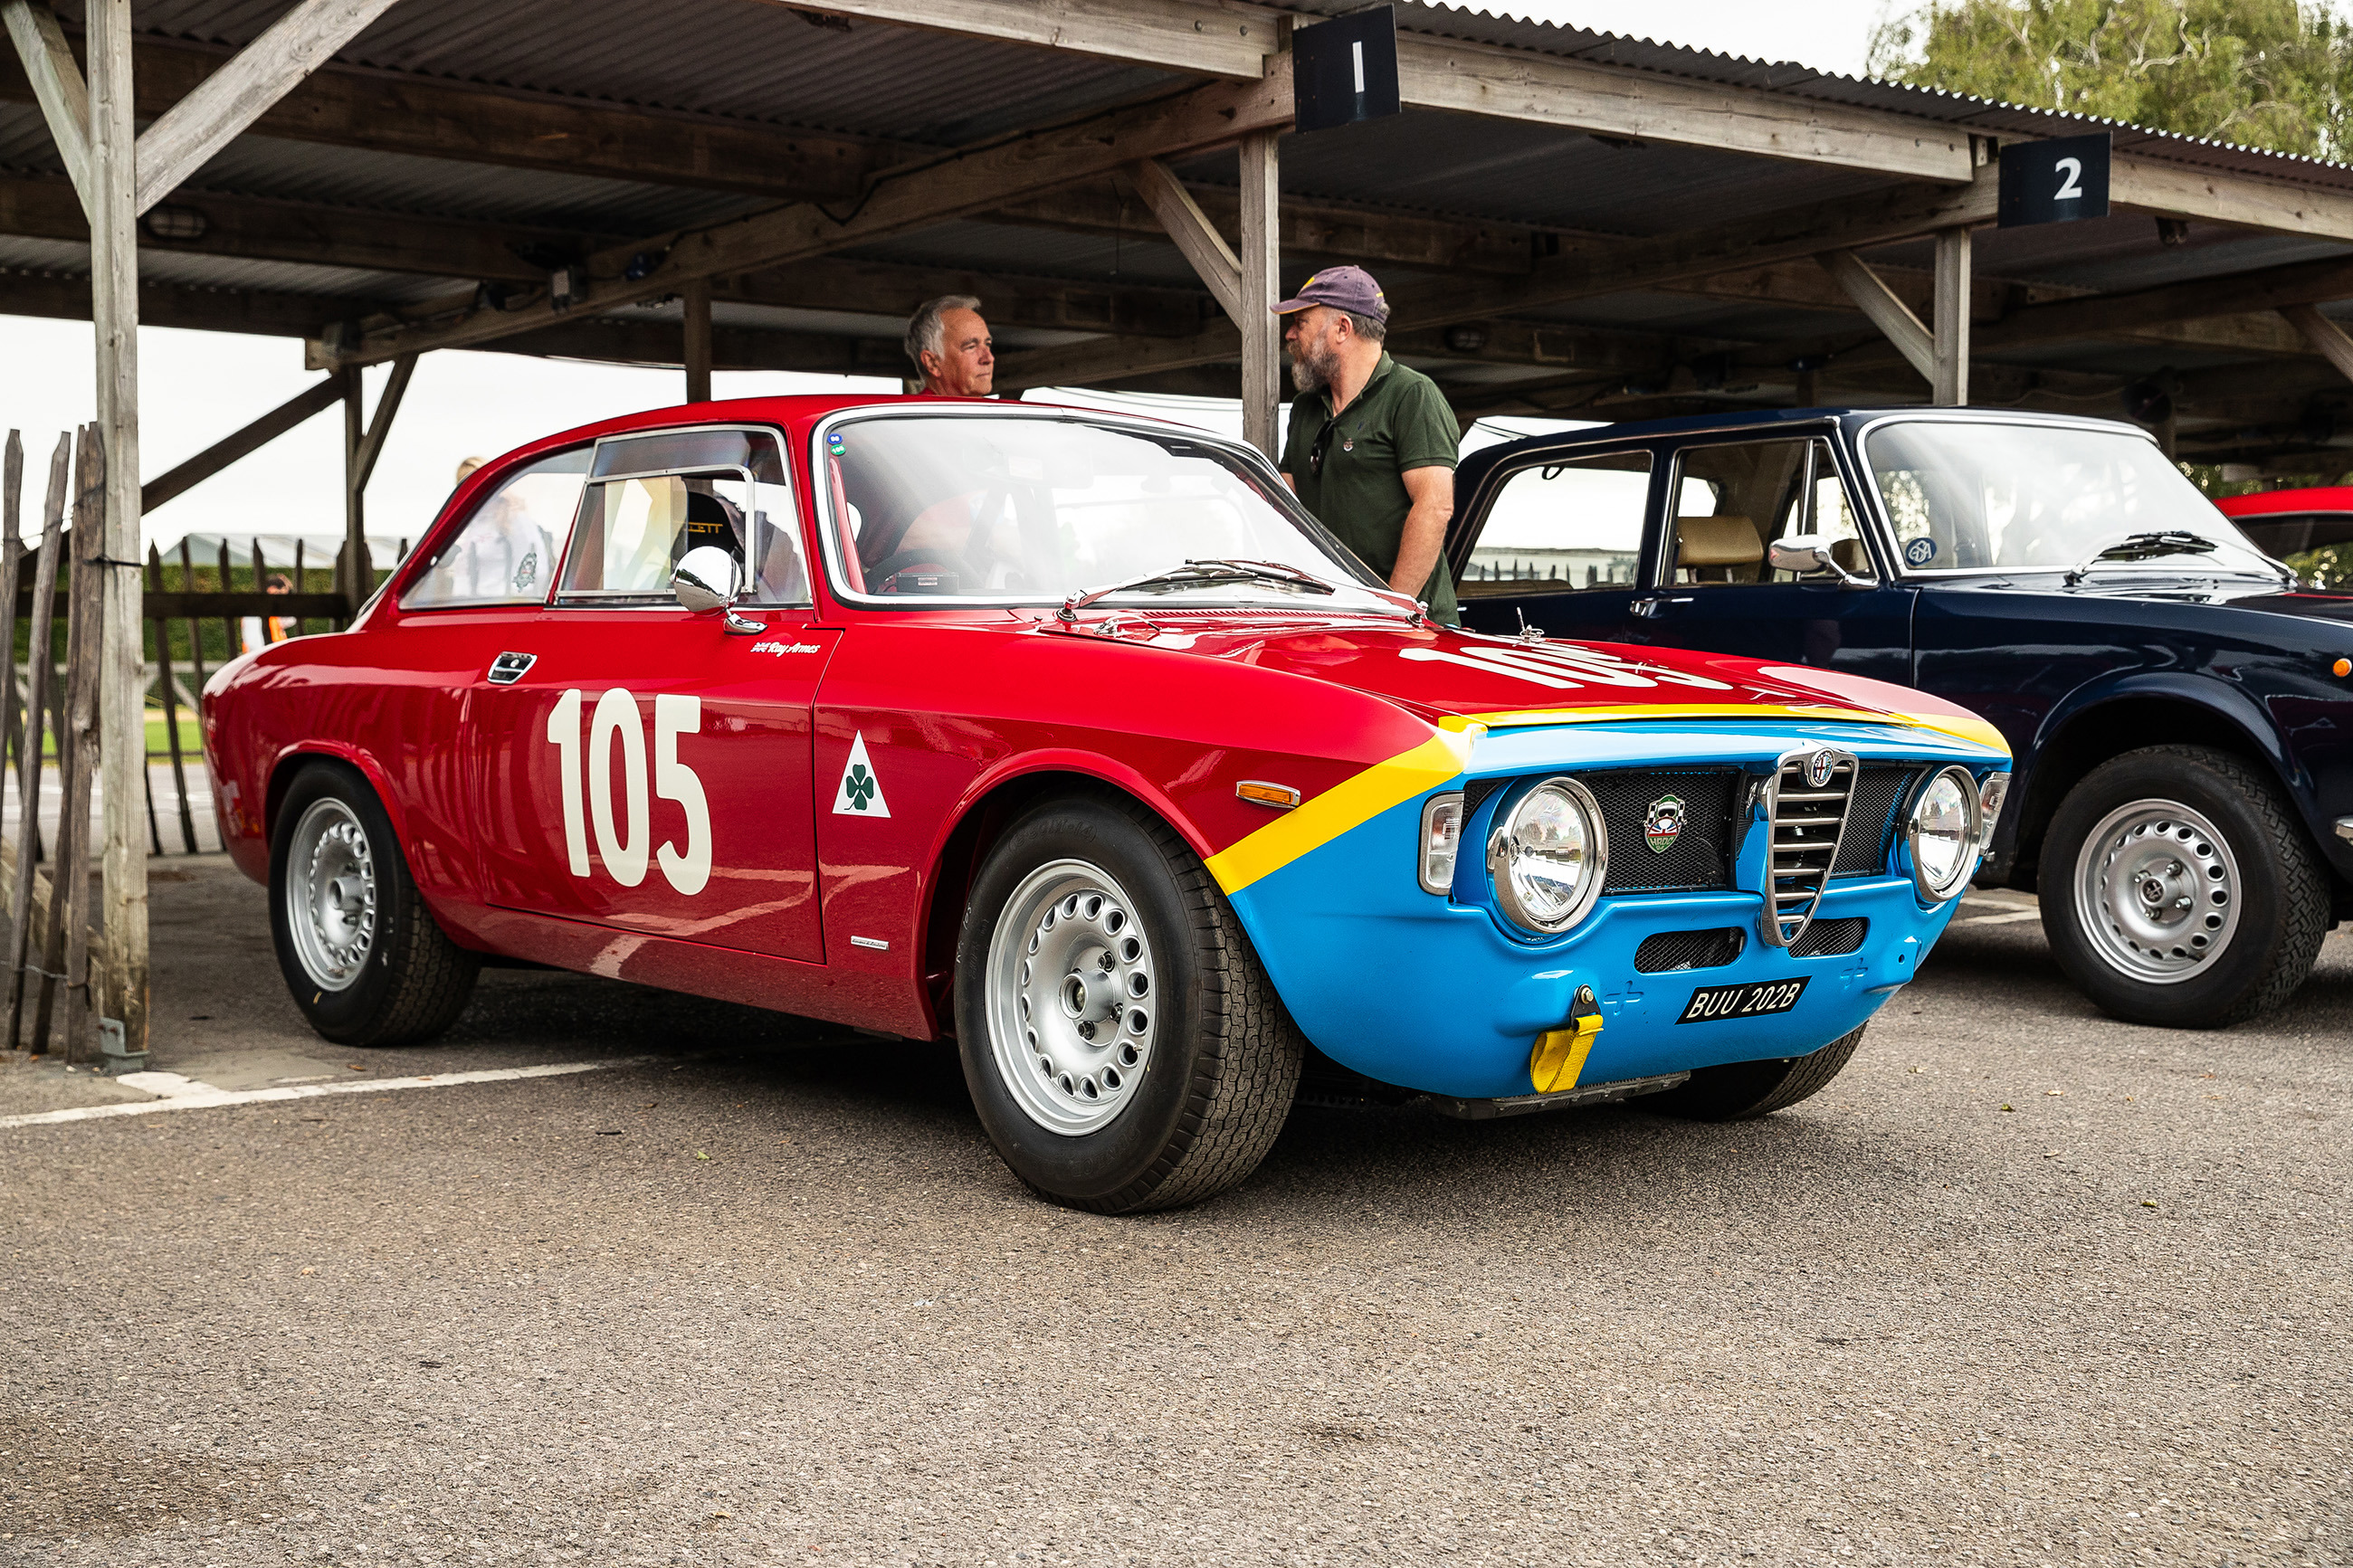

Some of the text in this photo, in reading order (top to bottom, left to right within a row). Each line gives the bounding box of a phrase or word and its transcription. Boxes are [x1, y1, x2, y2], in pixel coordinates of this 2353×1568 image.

[1352, 41, 1365, 93] 1
[2053, 157, 2083, 201] 2
[767, 641, 821, 657] Ray Armes
[1398, 645, 1734, 689] 105
[548, 688, 712, 896] 105
[1686, 983, 1801, 1019] BUU 202B
